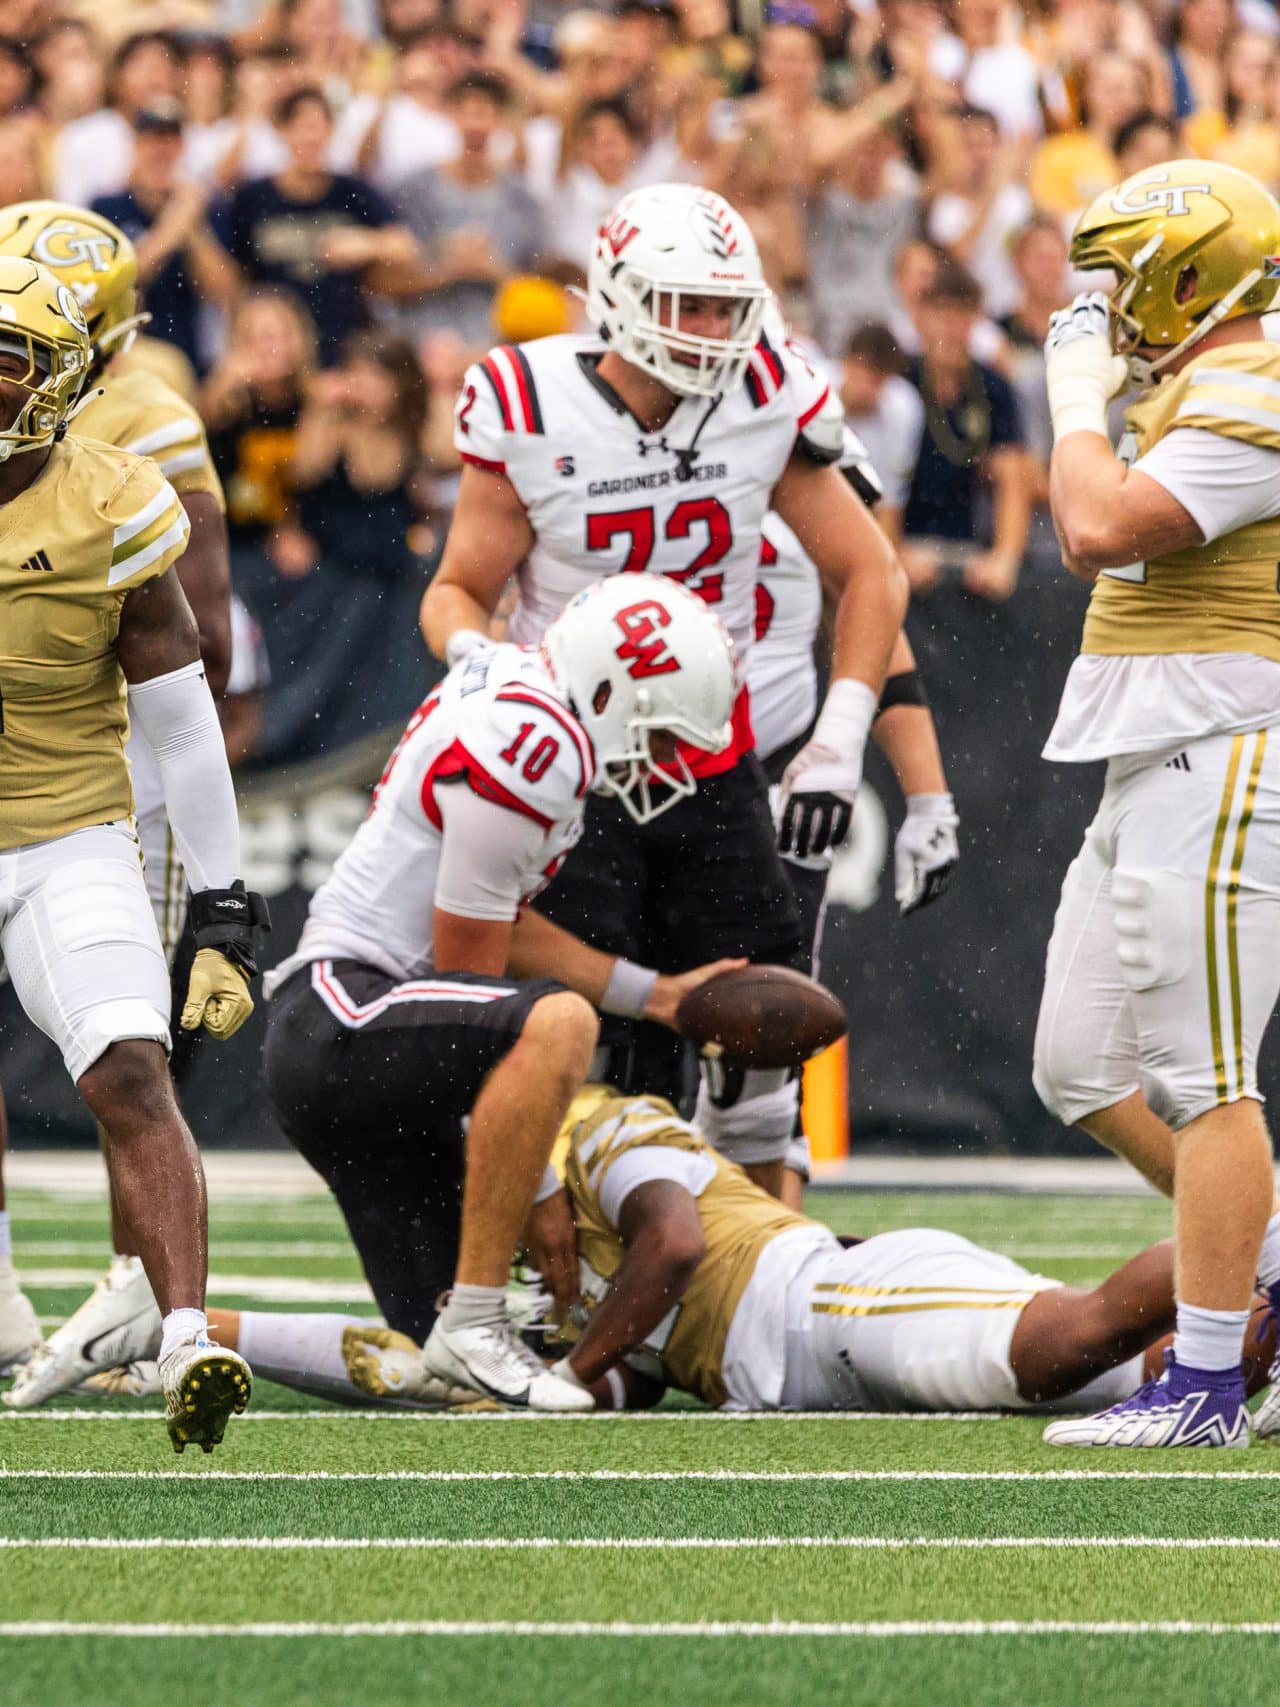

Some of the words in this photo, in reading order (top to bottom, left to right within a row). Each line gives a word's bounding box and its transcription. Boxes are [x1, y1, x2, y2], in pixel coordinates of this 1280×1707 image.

[1111, 173, 1210, 217] GT
[34, 224, 117, 272] GT
[586, 497, 733, 605] 72
[613, 599, 681, 681] GW
[499, 721, 560, 784] 10
